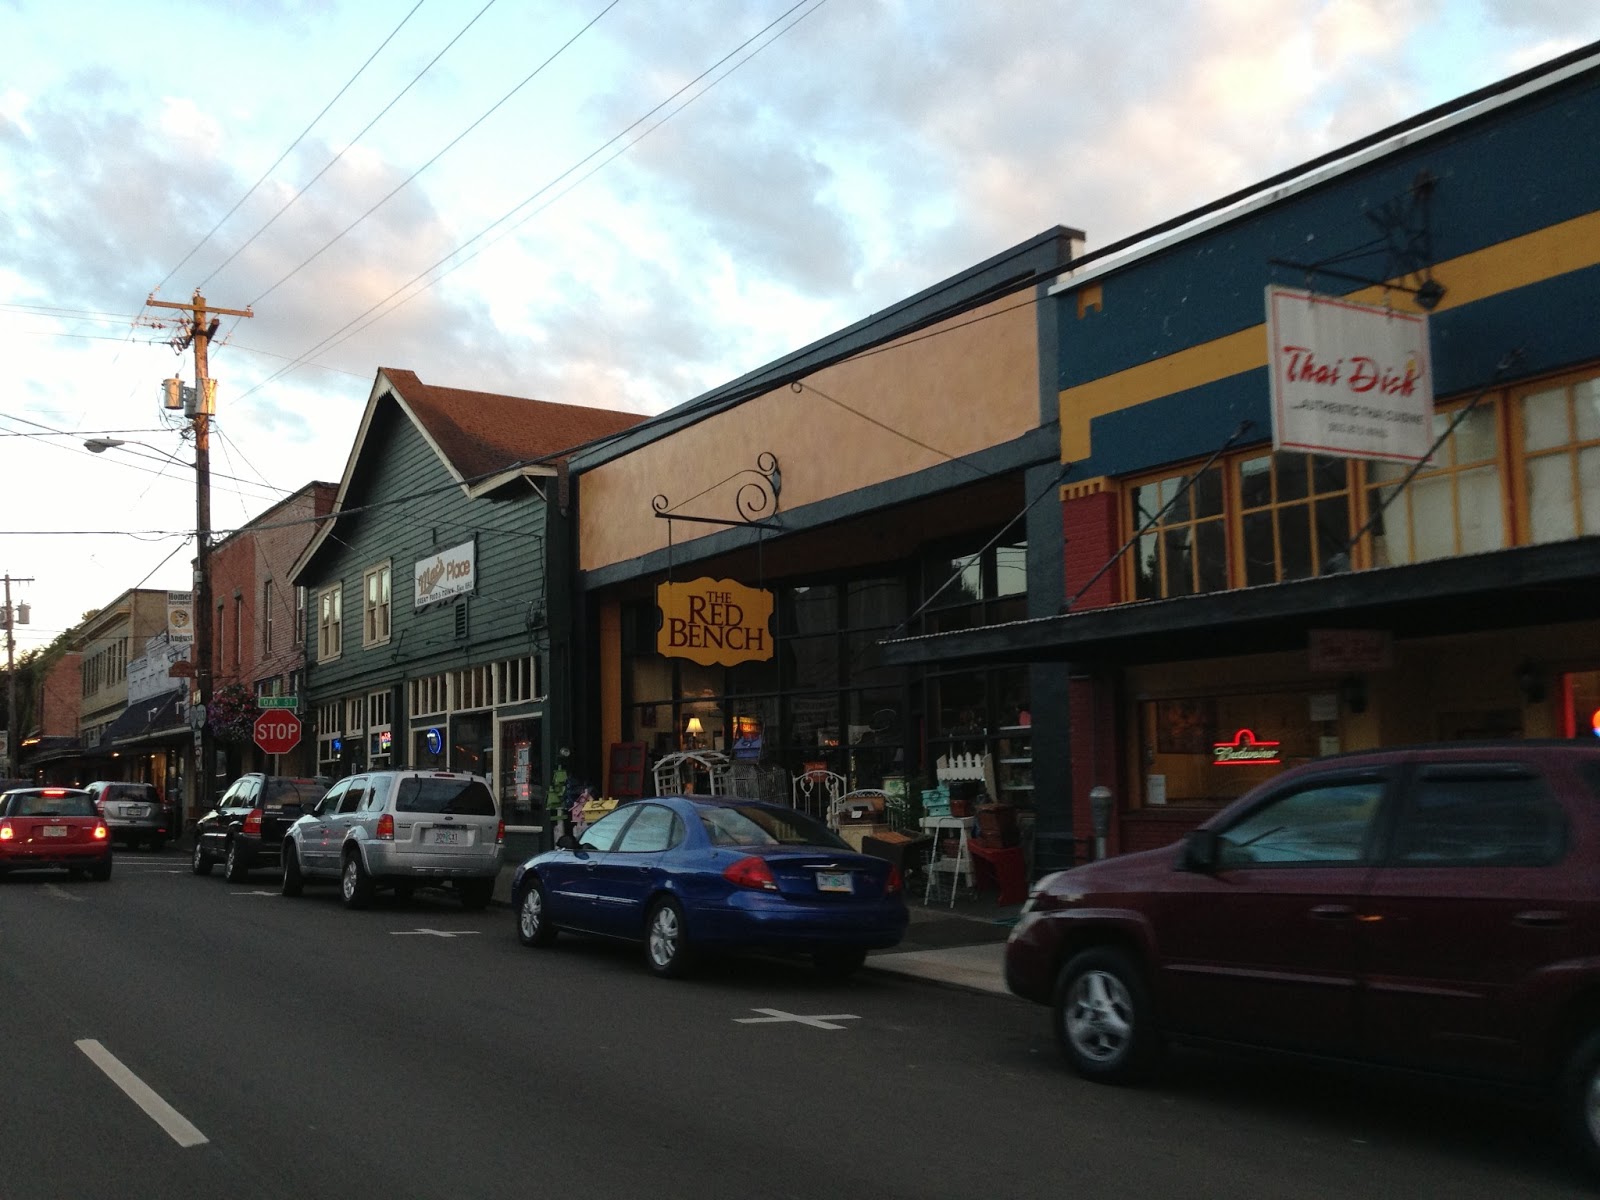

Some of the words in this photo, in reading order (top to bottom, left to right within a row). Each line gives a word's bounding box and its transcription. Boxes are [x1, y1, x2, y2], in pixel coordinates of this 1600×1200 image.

[1282, 346, 1342, 384] Thai
[1349, 356, 1421, 397] Dish
[168, 592, 192, 600] Homer
[706, 591, 732, 603] THE
[688, 595, 743, 627] RED
[171, 634, 193, 642] August
[668, 618, 764, 651] BENCH
[257, 723, 298, 740] STOP
[1213, 746, 1279, 761] Budweiser
